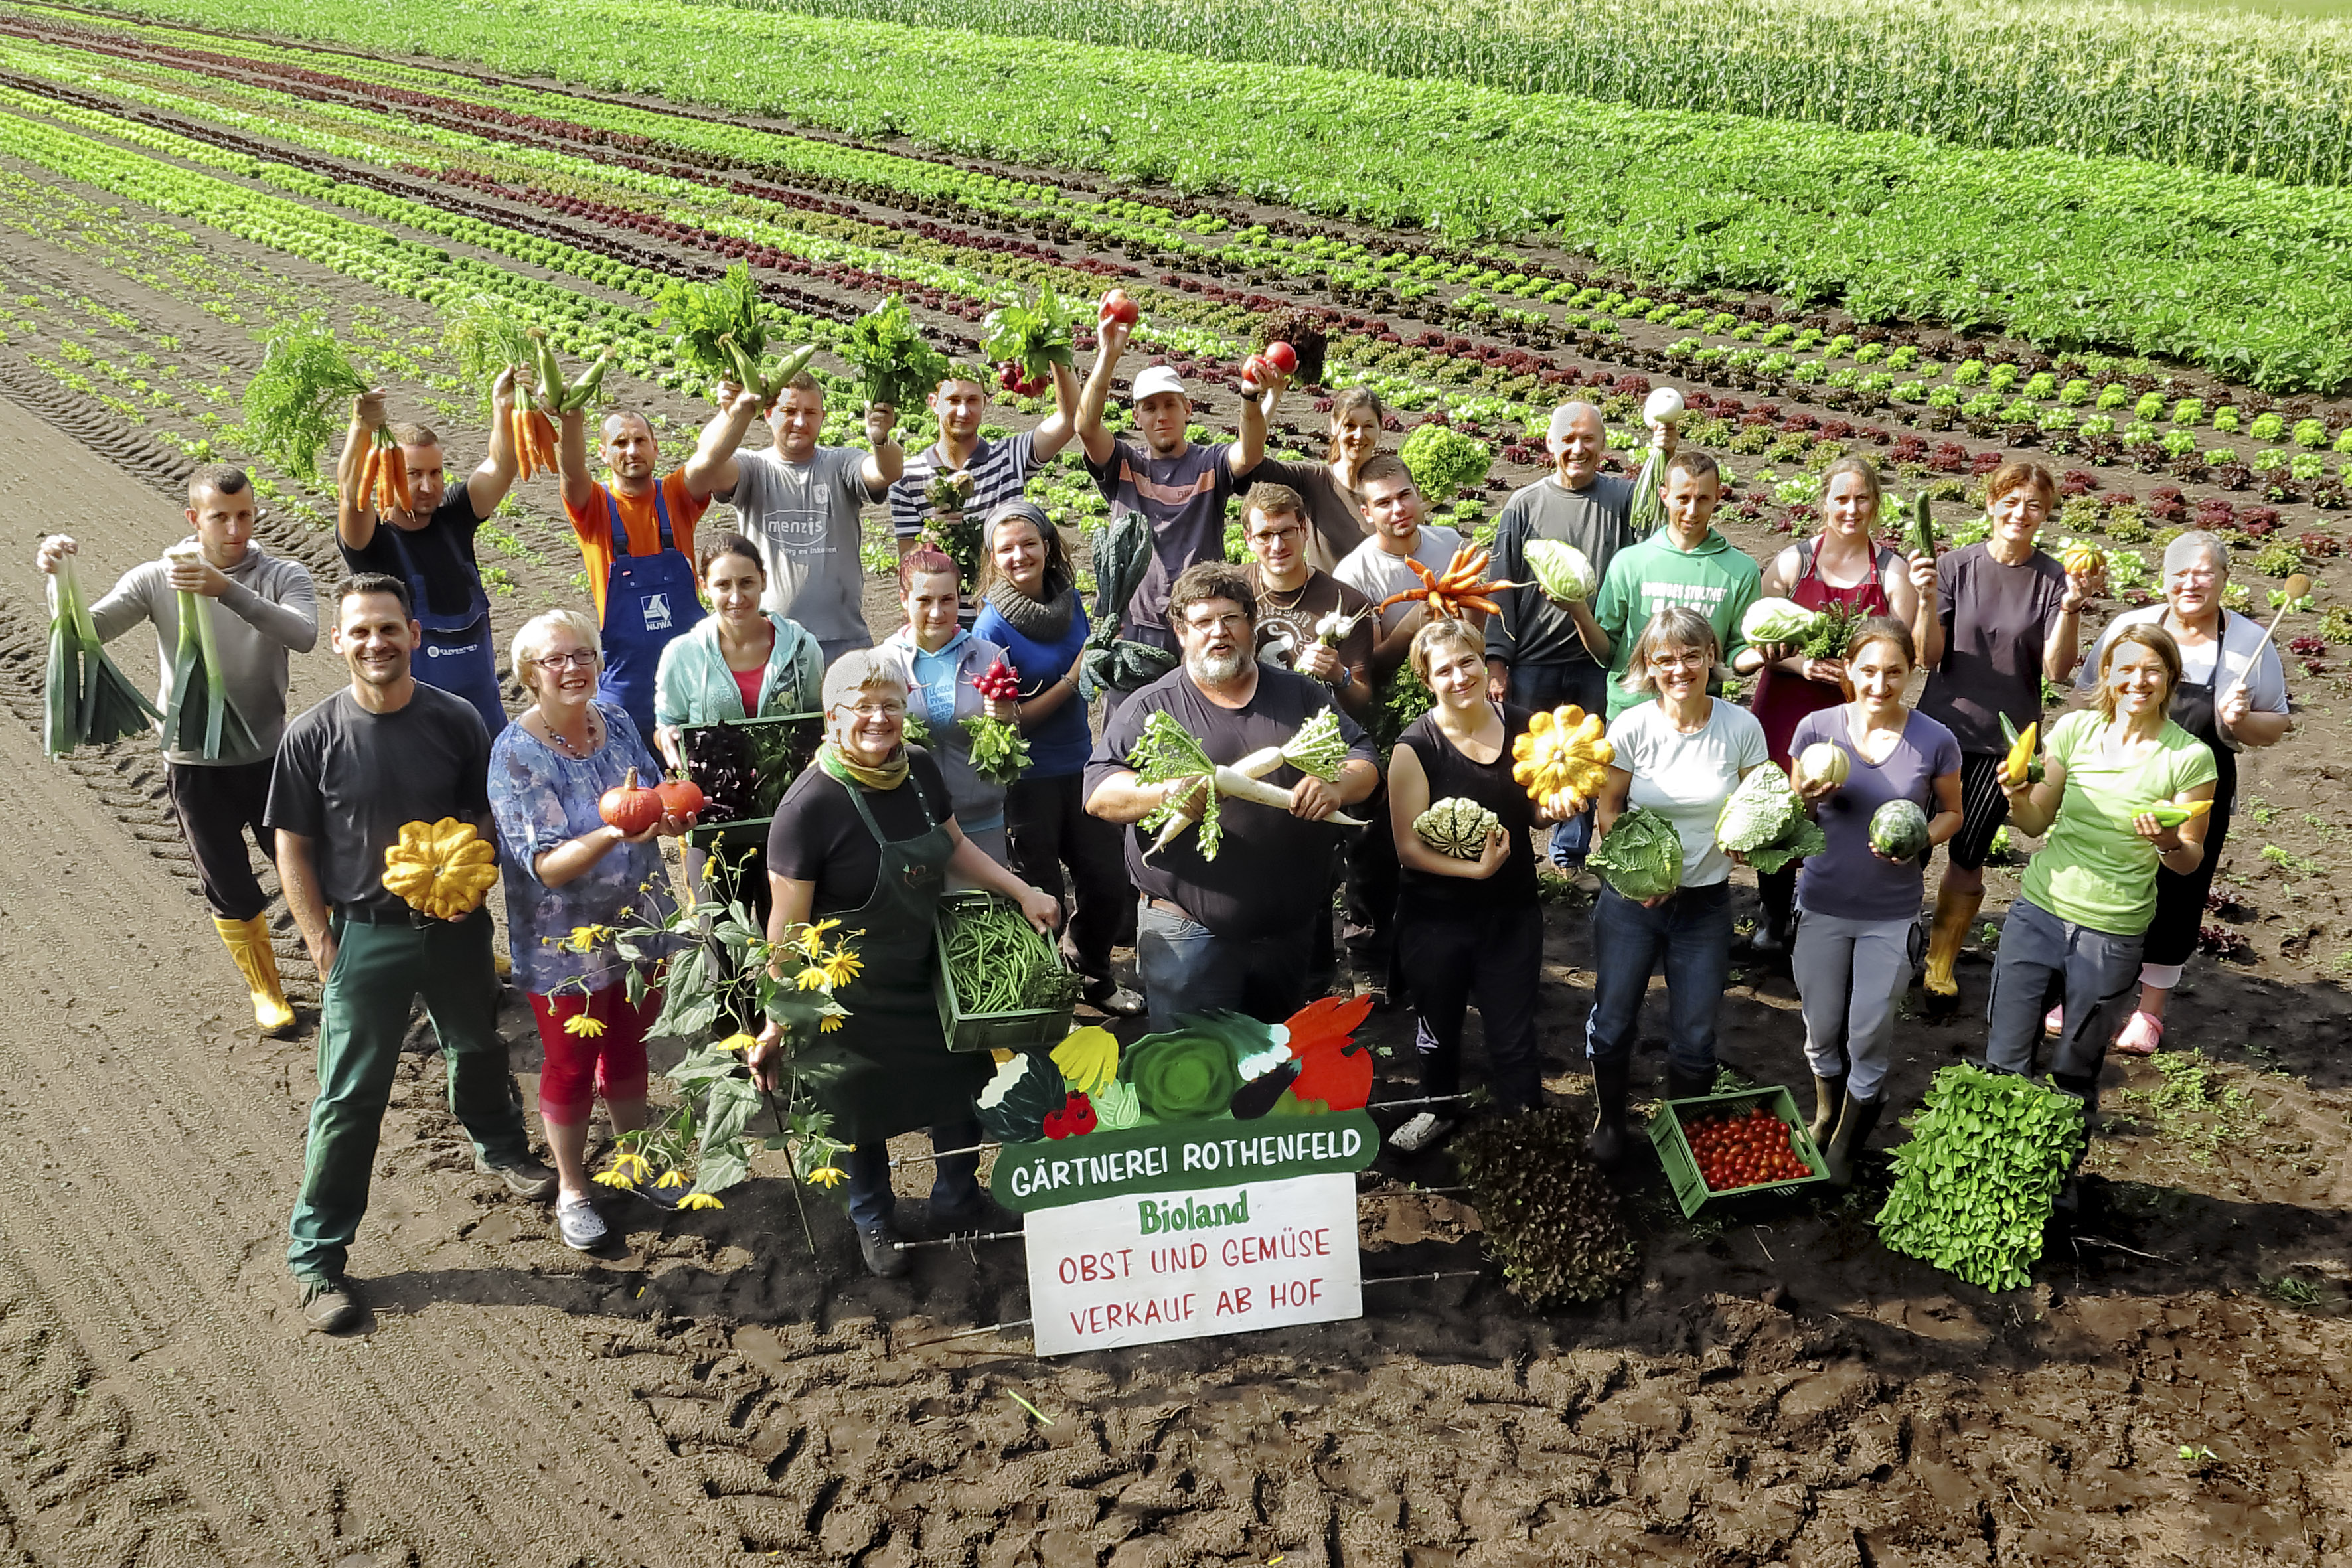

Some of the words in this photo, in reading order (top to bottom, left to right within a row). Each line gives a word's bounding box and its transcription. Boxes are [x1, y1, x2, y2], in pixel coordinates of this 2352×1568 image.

[768, 517, 823, 536] menzis
[1651, 599, 1715, 617] BAEN
[929, 684, 954, 696] LONDON
[930, 694, 953, 704] PARIS
[1012, 1147, 1167, 1196] GÄRTNEREI
[1184, 1129, 1360, 1171] ROTHENFELD
[1140, 1191, 1248, 1234] Bioland
[1059, 1249, 1131, 1283] OBST
[1152, 1243, 1206, 1272] UND
[1223, 1229, 1330, 1266] GEMÜSE
[1071, 1294, 1194, 1334] VERKAUF
[1216, 1287, 1251, 1316] AB
[1271, 1279, 1322, 1308] HOF
